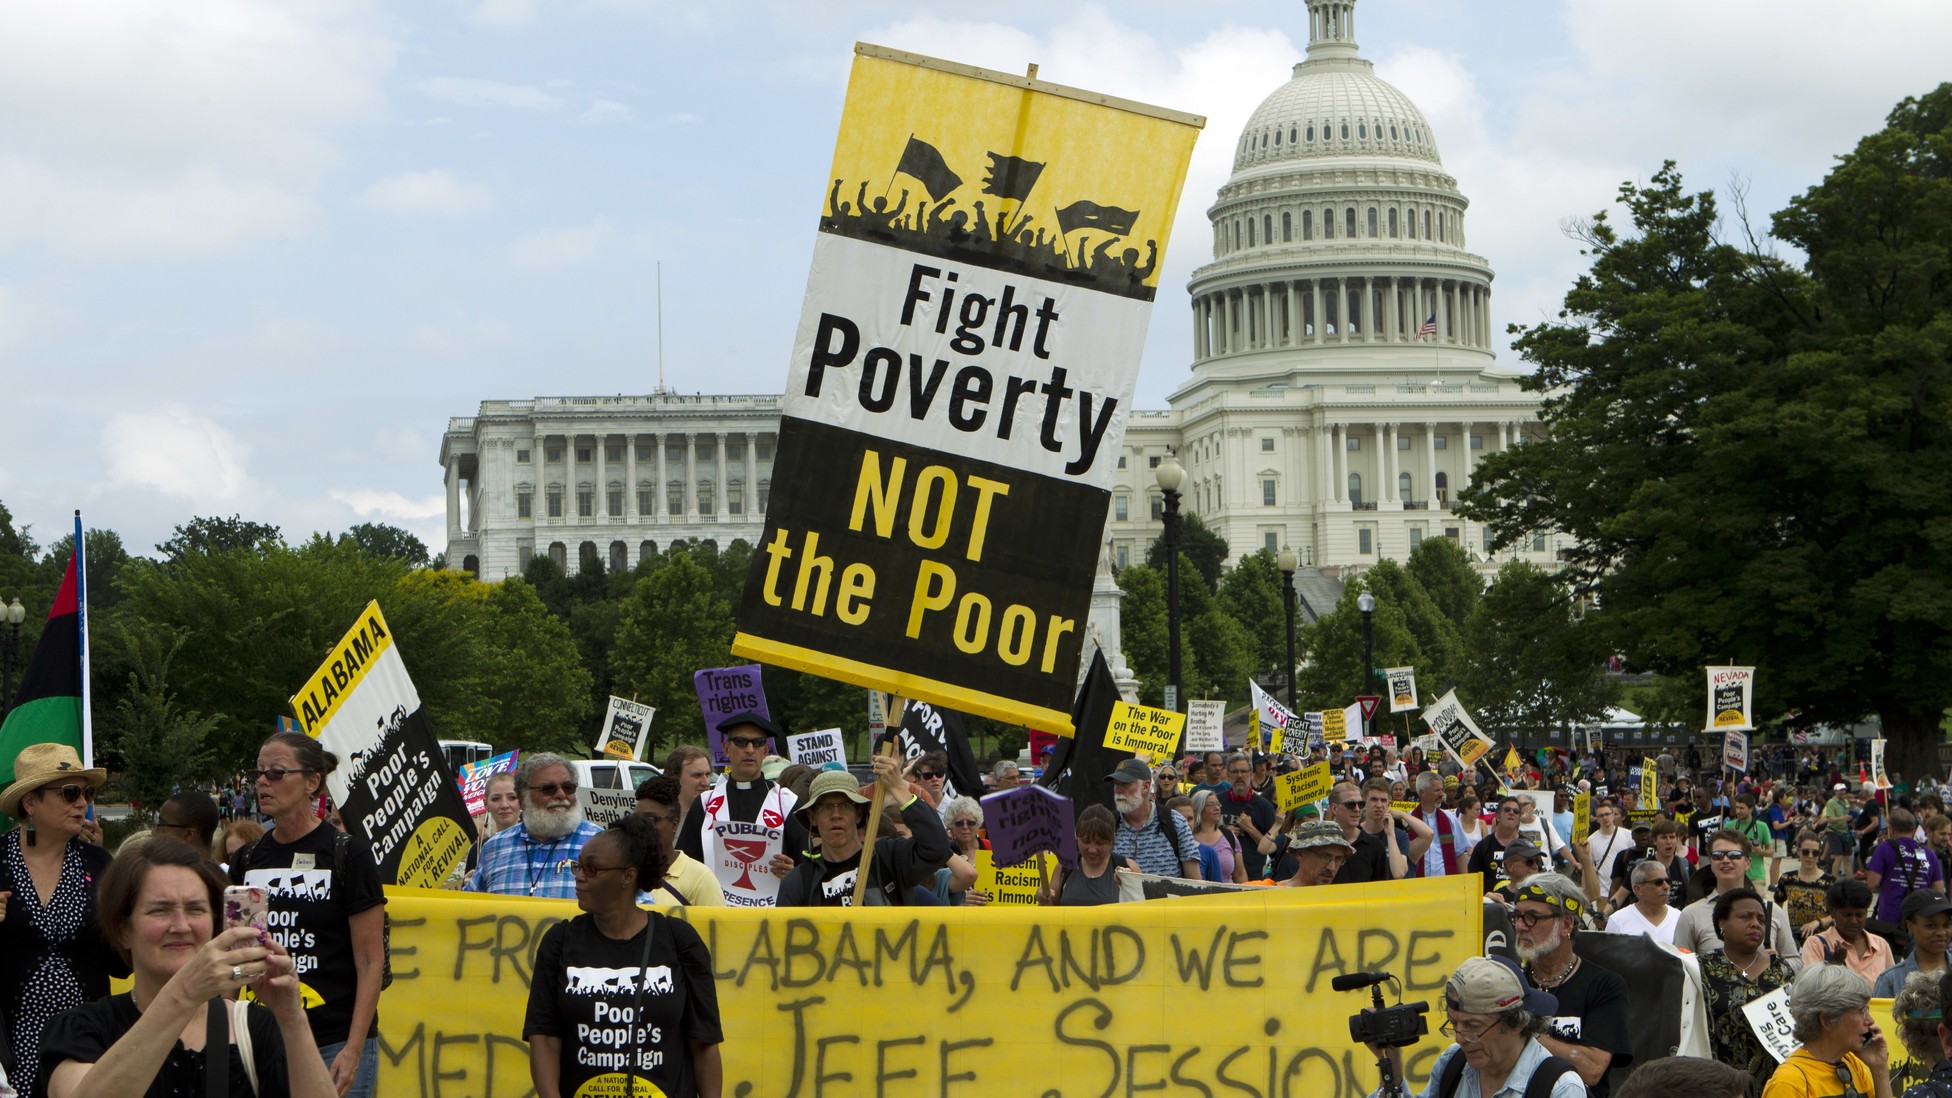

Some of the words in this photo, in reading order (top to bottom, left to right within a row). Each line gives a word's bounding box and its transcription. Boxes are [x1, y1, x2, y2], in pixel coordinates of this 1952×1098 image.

[900, 263, 1059, 359] Fight
[804, 312, 1118, 475] Poverty
[848, 449, 1010, 563] NOT
[762, 528, 877, 626] the
[905, 559, 1075, 674] Poor
[301, 615, 387, 733] ALABAMA
[702, 671, 752, 691] Trans
[1714, 671, 1750, 684] NEVADA
[708, 690, 758, 714] rights
[1717, 695, 1741, 704] People's
[1722, 690, 1736, 698] Poor
[613, 698, 650, 717] CONNECTICUT
[1127, 705, 1147, 721] The
[1149, 710, 1171, 725] War
[1717, 702, 1742, 710] Campaign
[1113, 721, 1127, 732] on
[1129, 721, 1147, 735] the
[1149, 725, 1176, 741] Poor
[1285, 727, 1308, 739] POVERTY
[1287, 718, 1310, 730] FIGHT
[796, 734, 834, 752] STAND
[1112, 732, 1122, 745] is
[1124, 734, 1169, 754] Immoral
[1282, 744, 1304, 756] POOR
[1283, 736, 1295, 746] NOT
[1295, 738, 1305, 747] THE
[798, 748, 837, 766] AGAINST
[366, 741, 407, 801] Poor
[465, 761, 510, 783] LOVE
[1286, 766, 1321, 785] Systemic
[362, 750, 430, 840] People's
[1285, 799, 1292, 808] is
[1294, 785, 1325, 804] Immoral
[1290, 779, 1318, 794] Racism
[590, 790, 636, 810] Denying
[370, 770, 442, 866] Campaign
[584, 806, 620, 823] Health
[415, 833, 424, 849] A
[715, 823, 780, 840] PUBLIC
[398, 842, 434, 886] NATIONAL
[432, 819, 450, 845] CALL
[431, 830, 468, 882] REVIVAL
[422, 855, 435, 874] FOR
[995, 871, 1041, 887] Racism
[721, 888, 775, 907] RESENCE
[268, 910, 299, 927] oor
[272, 928, 315, 948] ple's
[454, 914, 567, 989] FRO
[676, 905, 976, 1013] LABAMA,
[1010, 923, 1146, 993] AND
[1170, 924, 1270, 992] WE
[1304, 927, 1455, 996] ARE
[1766, 1000, 1792, 1036] Care
[577, 1023, 662, 1049] People's
